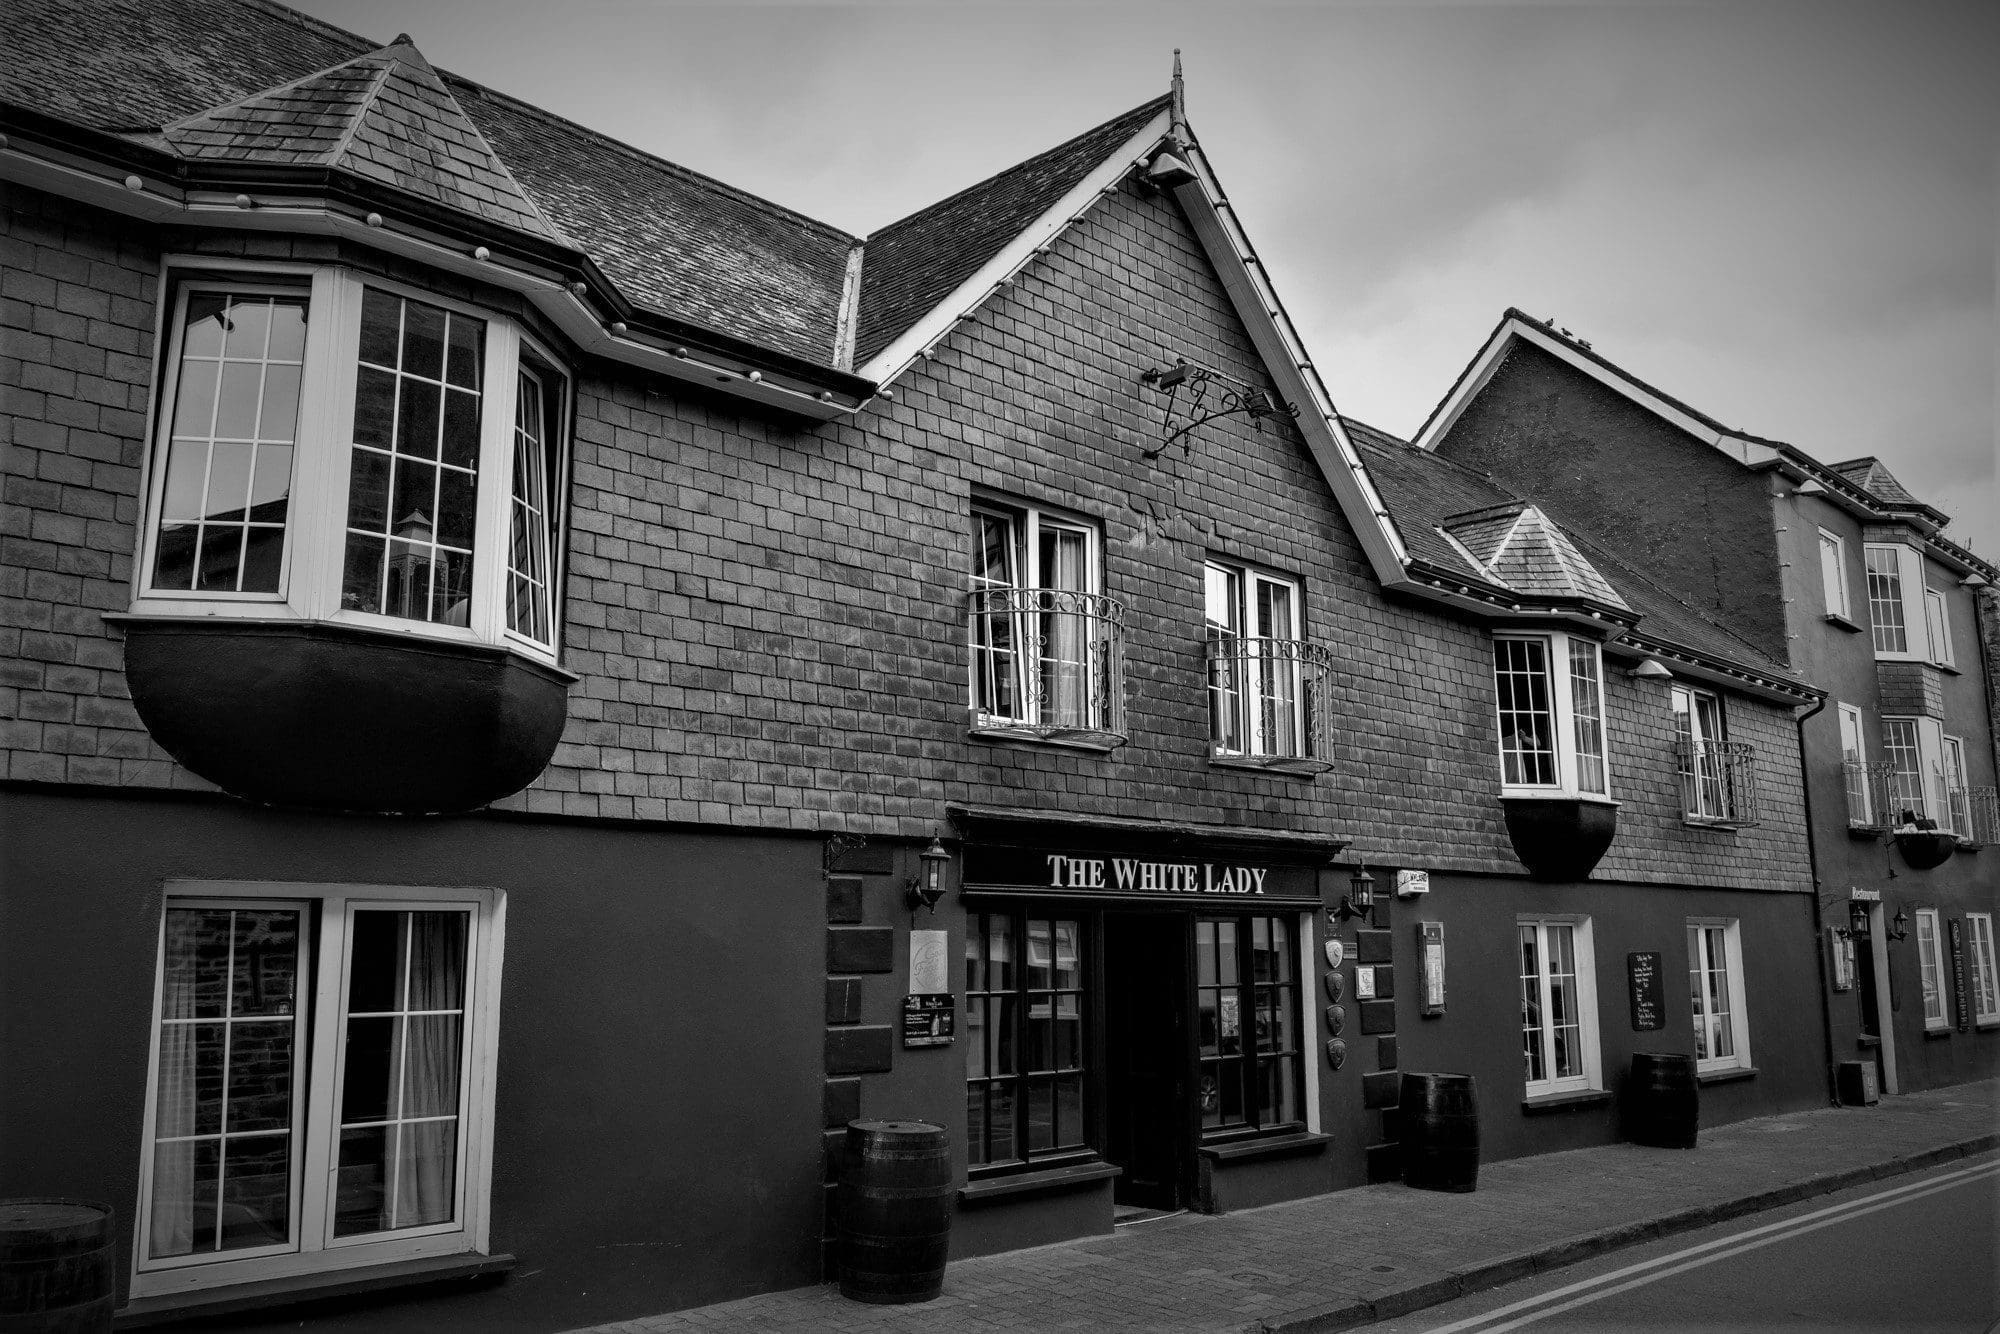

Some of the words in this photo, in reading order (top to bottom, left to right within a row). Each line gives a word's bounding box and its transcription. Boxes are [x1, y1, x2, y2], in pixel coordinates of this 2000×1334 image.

[1047, 854, 1106, 888] THE
[1112, 858, 1198, 892] WHITE
[1204, 863, 1268, 894] LADY
